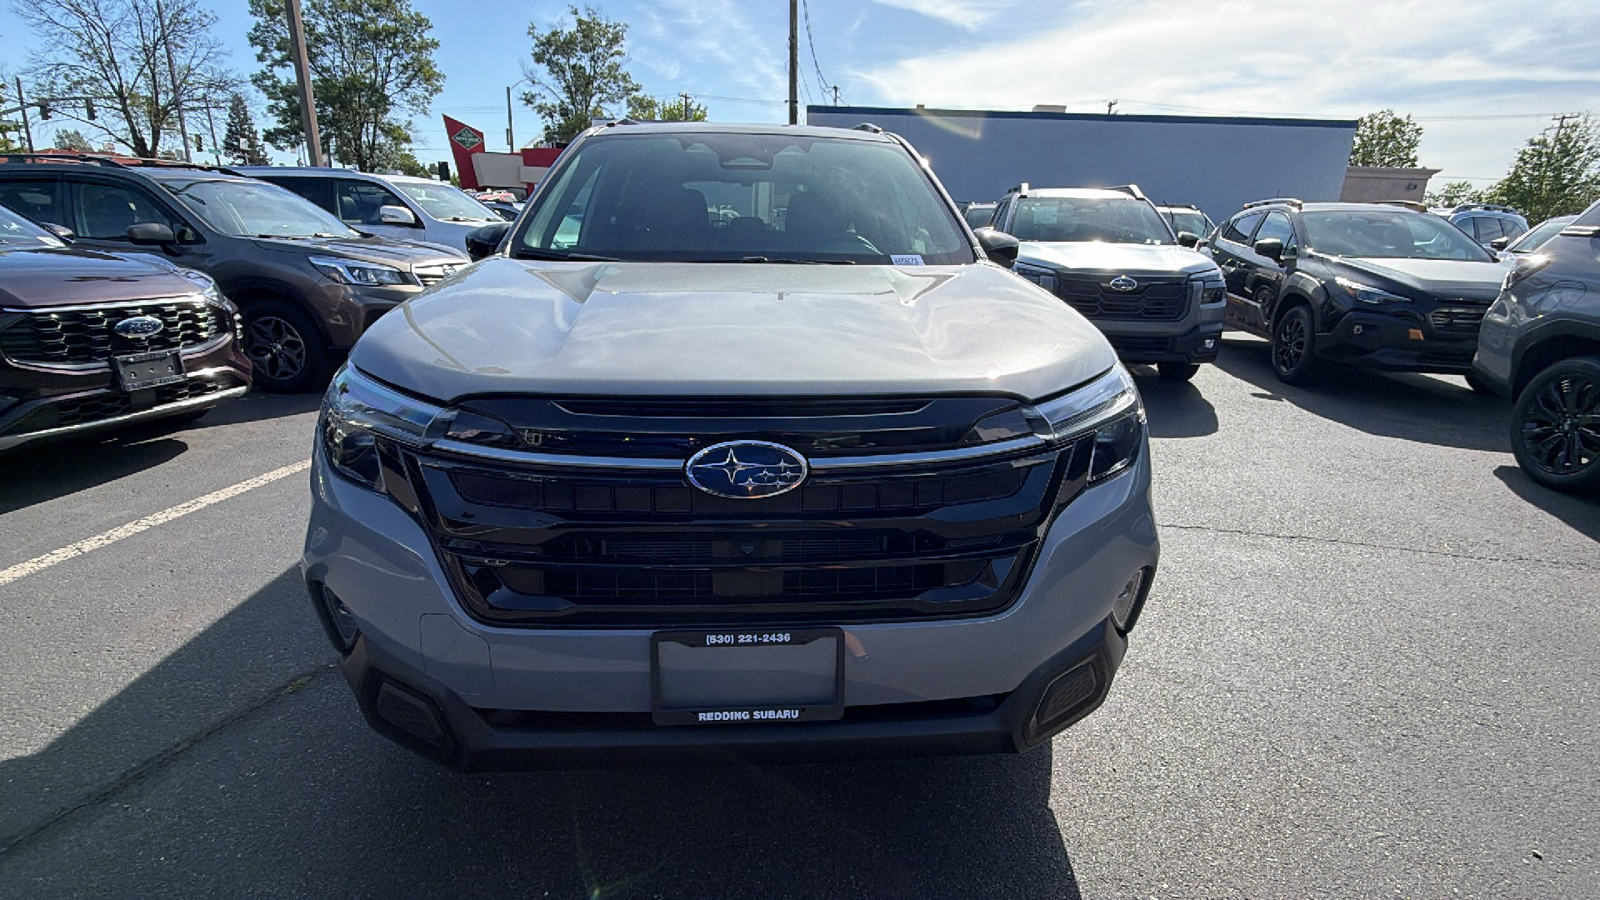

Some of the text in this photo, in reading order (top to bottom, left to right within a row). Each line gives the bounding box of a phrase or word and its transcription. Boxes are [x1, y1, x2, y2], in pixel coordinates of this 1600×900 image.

[706, 633, 791, 645] (530) 221-2436
[698, 709, 799, 721] REDDING SUBARU
